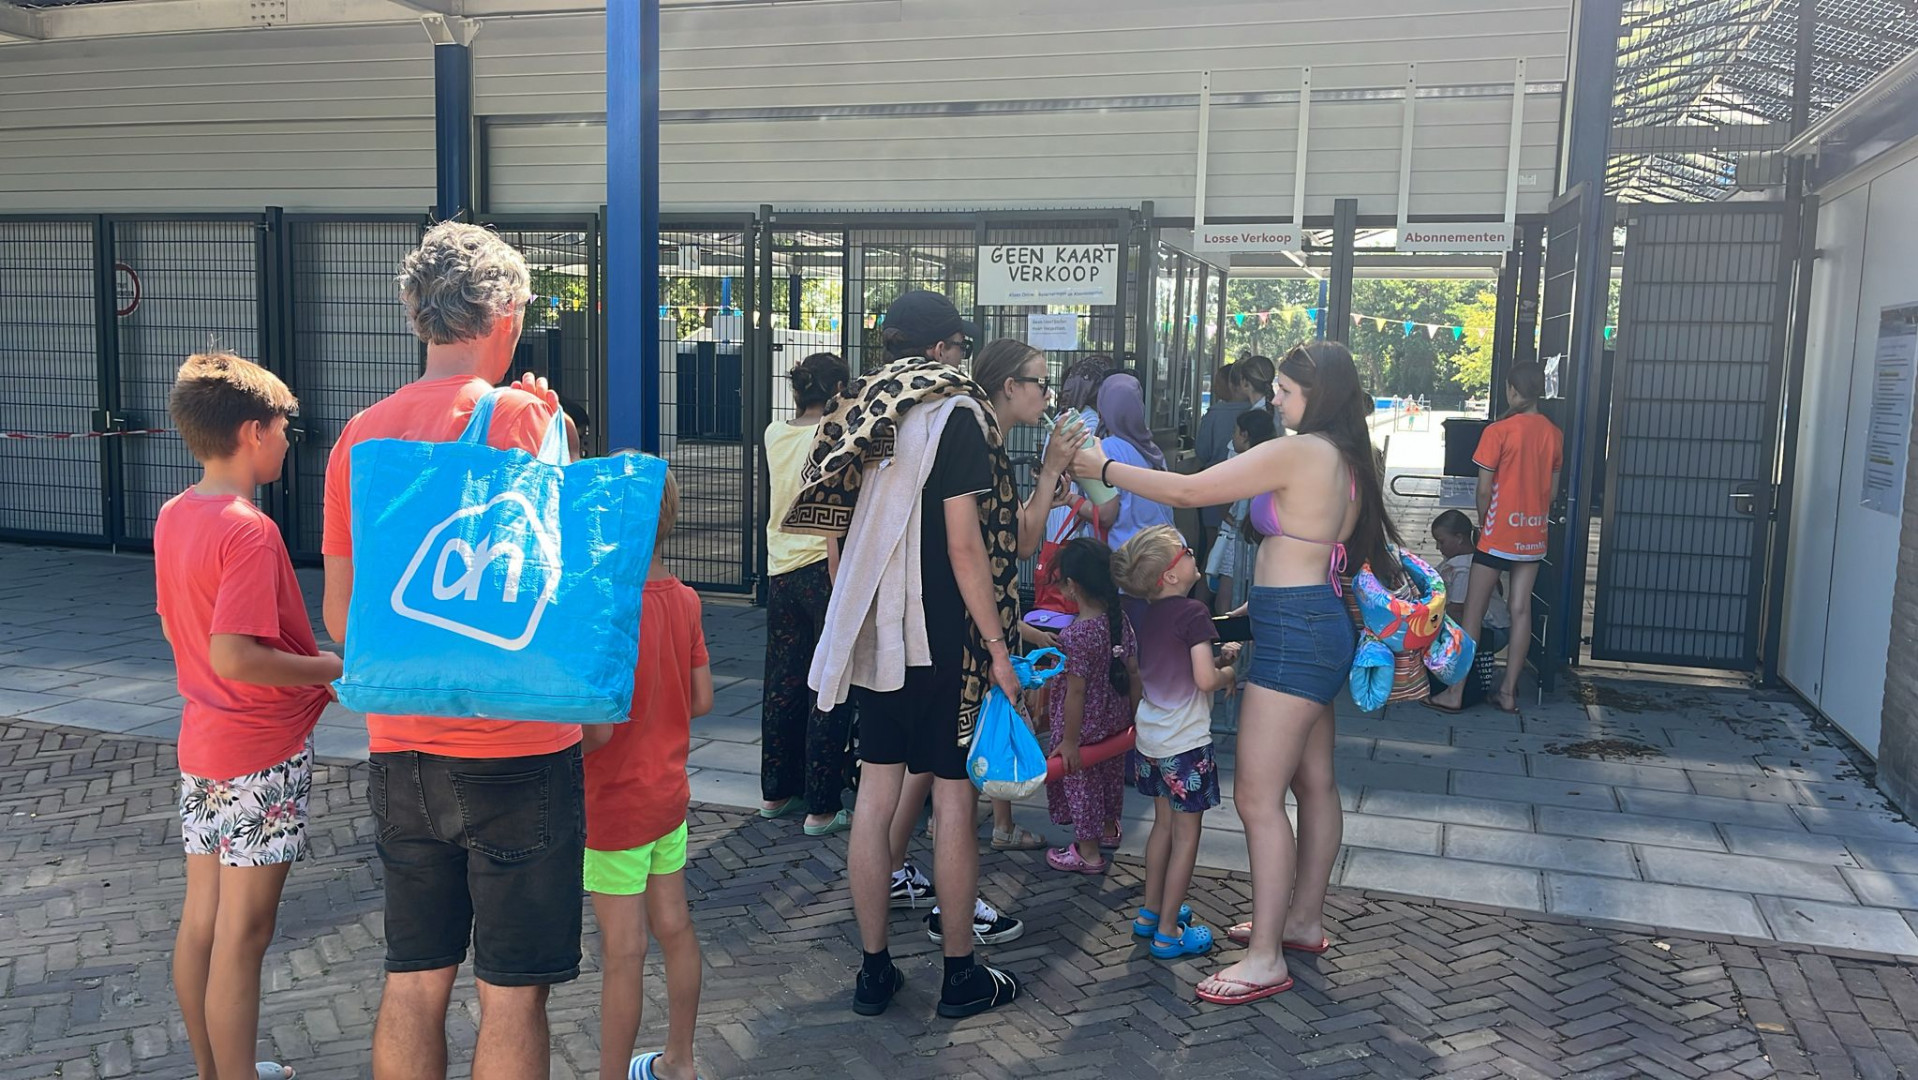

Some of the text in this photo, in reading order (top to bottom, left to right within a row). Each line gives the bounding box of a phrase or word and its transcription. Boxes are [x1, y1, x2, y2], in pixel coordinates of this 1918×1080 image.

[1204, 233, 1292, 244] Losse Verkoop
[1404, 232, 1505, 243] Abonnementen
[991, 247, 1116, 264] GEEN KAART
[1009, 265, 1099, 282] VERKOOP
